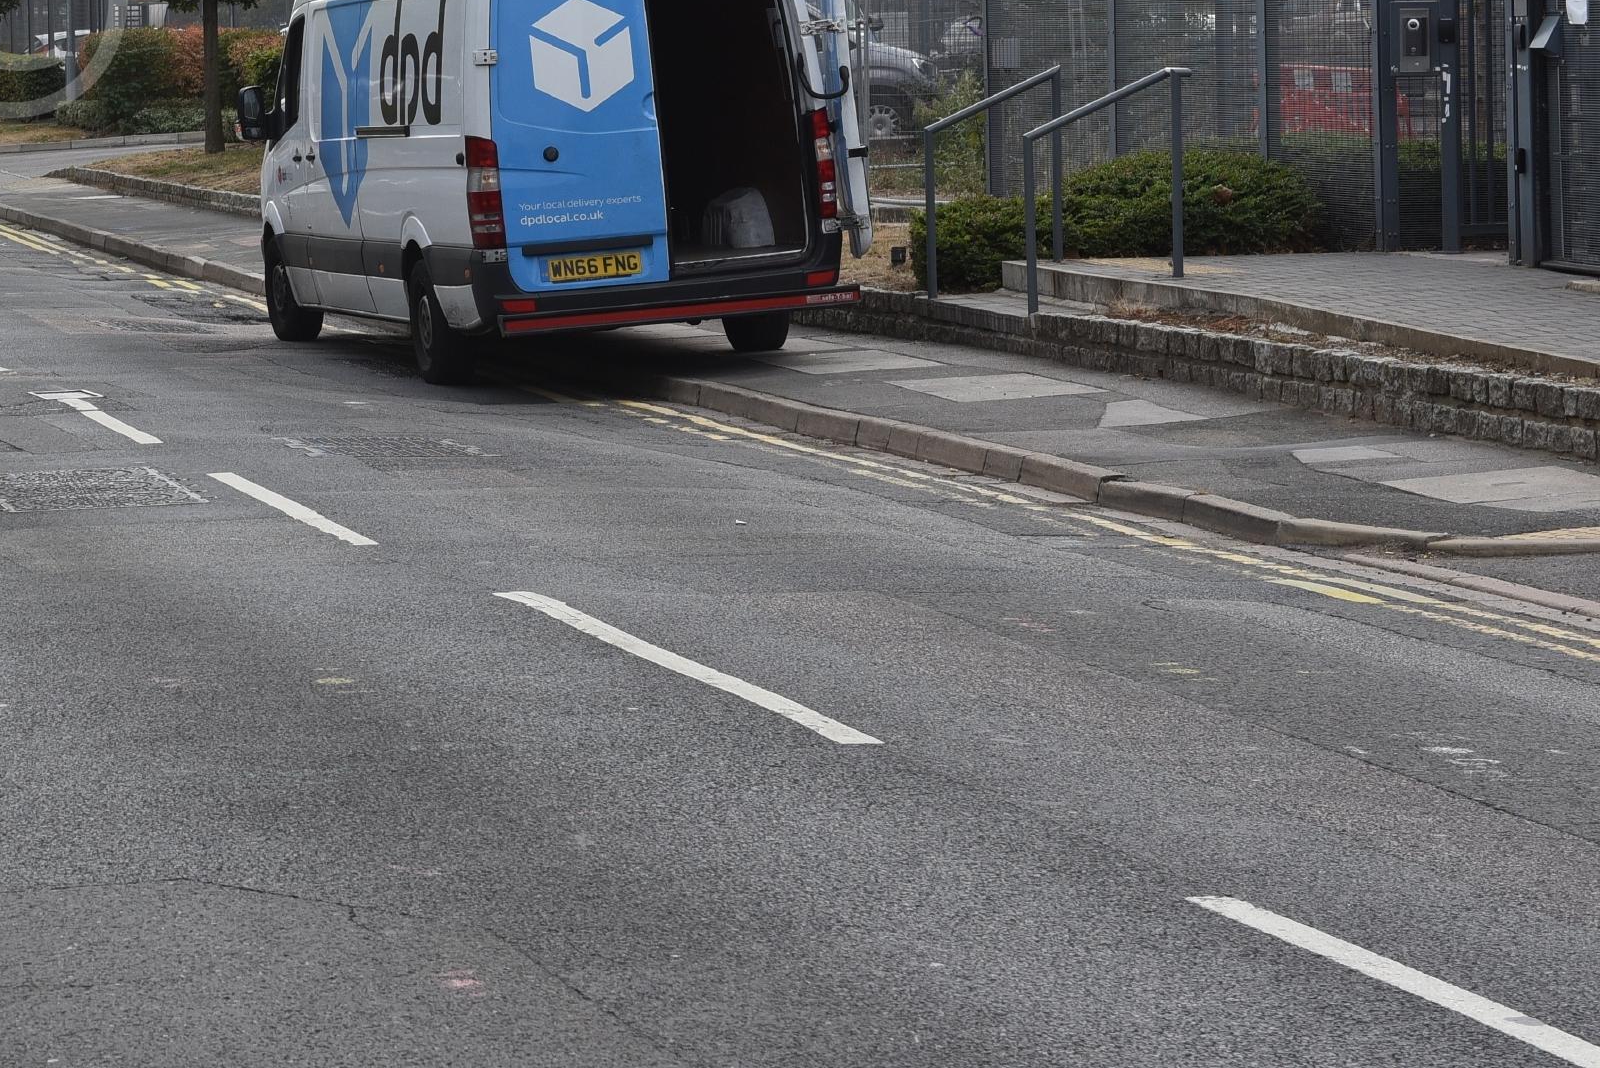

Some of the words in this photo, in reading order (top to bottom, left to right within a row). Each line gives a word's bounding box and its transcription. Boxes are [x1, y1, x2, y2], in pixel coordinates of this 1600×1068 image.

[519, 203, 541, 211] Your
[542, 199, 565, 209] local
[567, 197, 604, 208] delivery
[607, 195, 642, 205] experts
[520, 210, 604, 227] dpdlocal.co.uk
[550, 258, 599, 278] WN66
[602, 254, 639, 274] FNG
